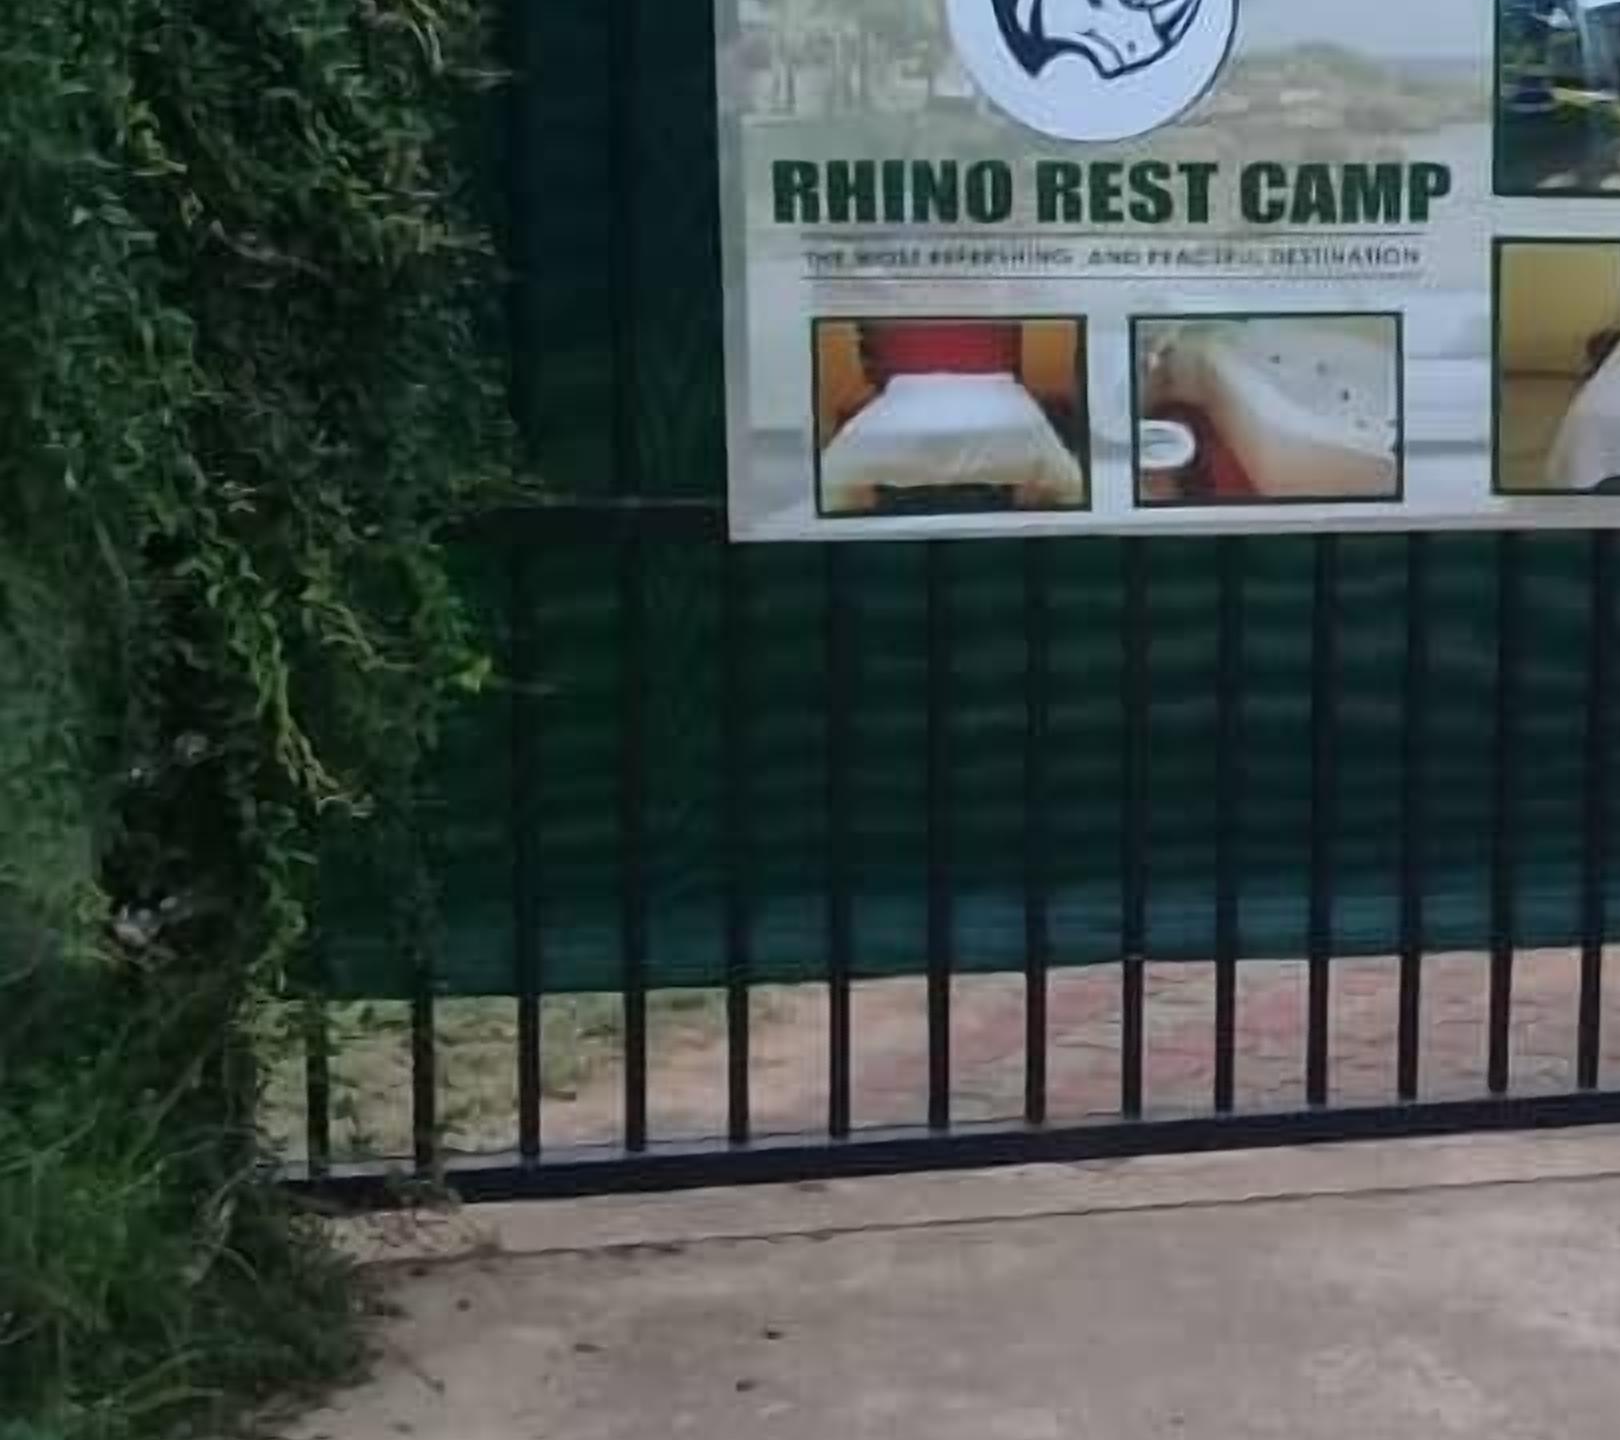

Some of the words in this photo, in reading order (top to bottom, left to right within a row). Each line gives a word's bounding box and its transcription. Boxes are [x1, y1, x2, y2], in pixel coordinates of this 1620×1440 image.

[772, 160, 1013, 224] RHINO
[1036, 160, 1218, 224] REST
[1240, 162, 1452, 224] CAMP
[804, 248, 850, 269] THE
[1087, 246, 1141, 268] AND
[1269, 244, 1423, 267] DESTINATION
